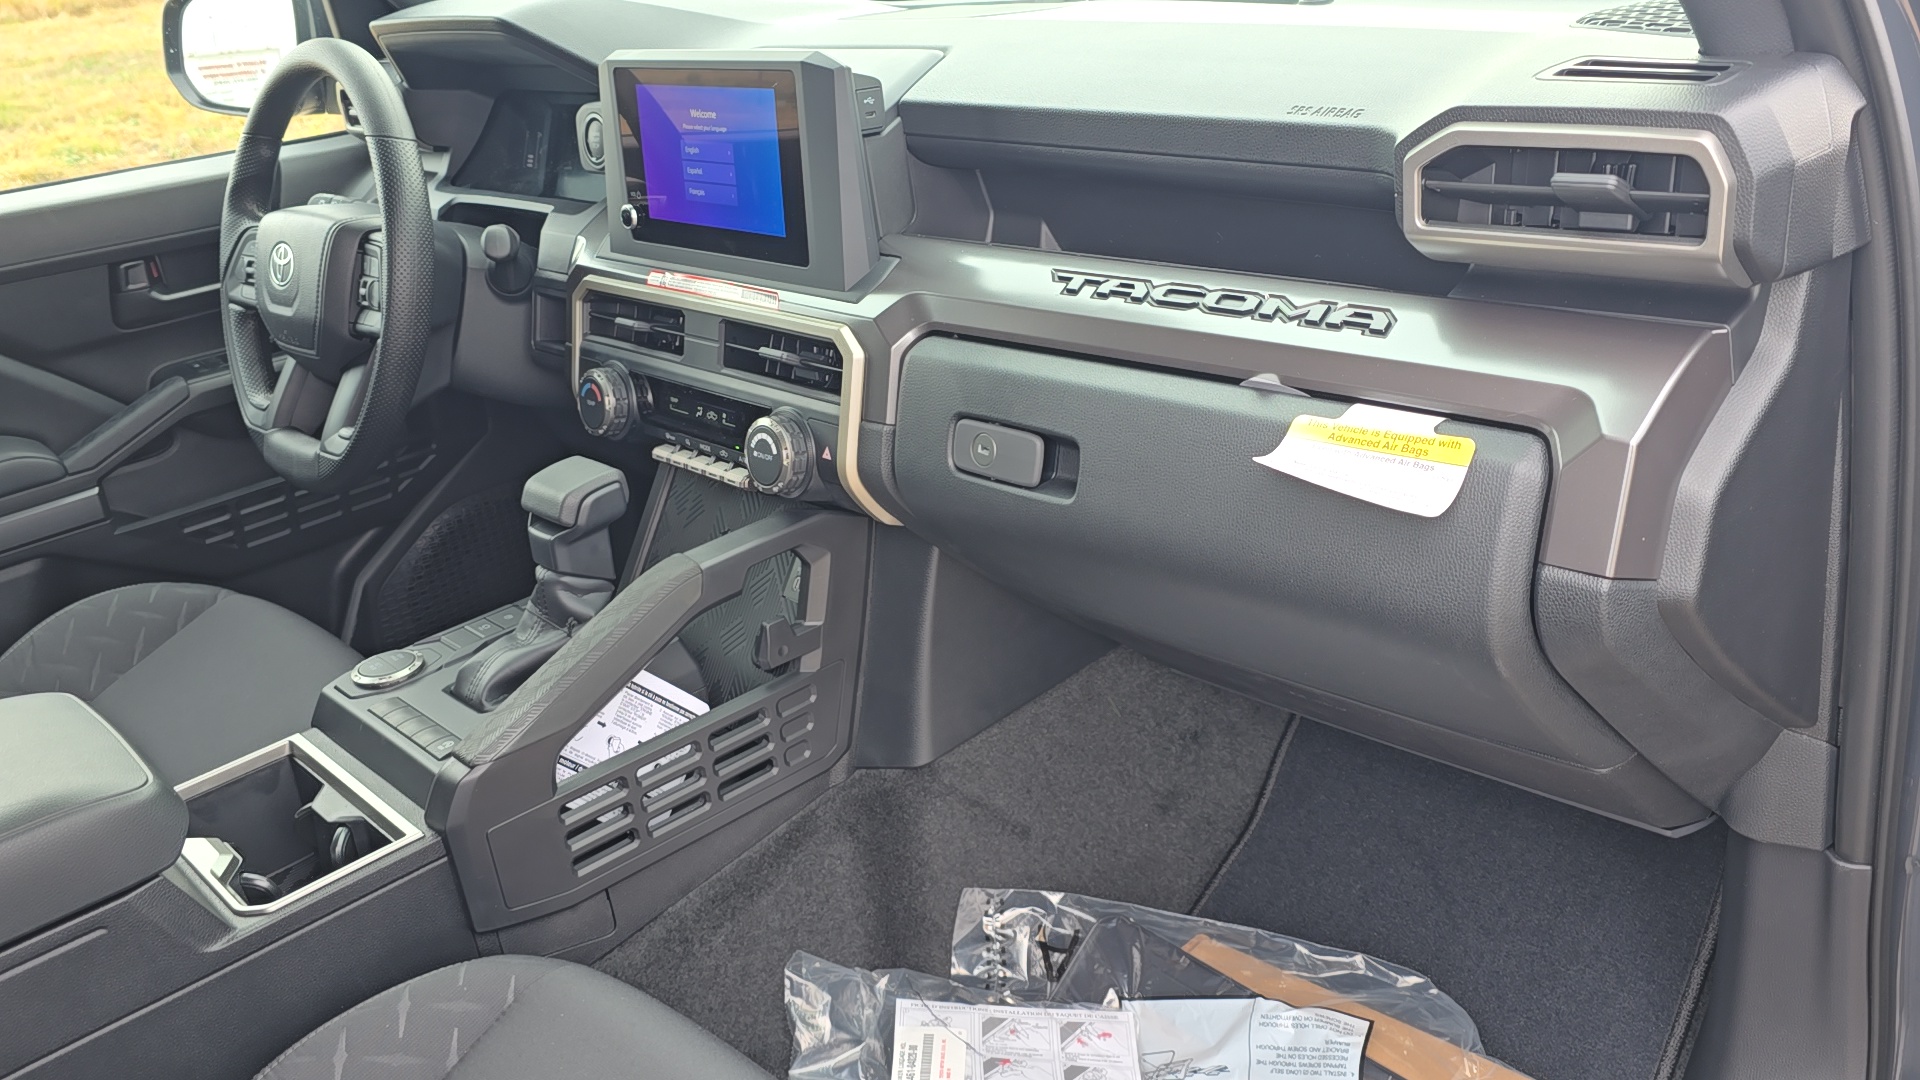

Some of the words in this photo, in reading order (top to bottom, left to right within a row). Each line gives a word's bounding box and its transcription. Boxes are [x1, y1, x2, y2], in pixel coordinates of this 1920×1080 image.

[690, 109, 717, 119] Welcome
[1286, 105, 1313, 115] SRS
[1310, 106, 1365, 118] AIRBAG
[685, 146, 699, 155] English
[1051, 268, 1398, 339] TACOMA
[1308, 418, 1328, 429] This
[1332, 422, 1369, 436] Vehicle
[1371, 428, 1380, 437] is
[1384, 430, 1436, 446] Equipped
[1438, 438, 1462, 450] with
[1328, 432, 1380, 448] Advanced
[1382, 440, 1398, 451] Air
[1401, 444, 1430, 458] Bags
[1354, 451, 1396, 464] Advanced
[1398, 458, 1410, 466] Air
[1412, 460, 1435, 472] Bags
